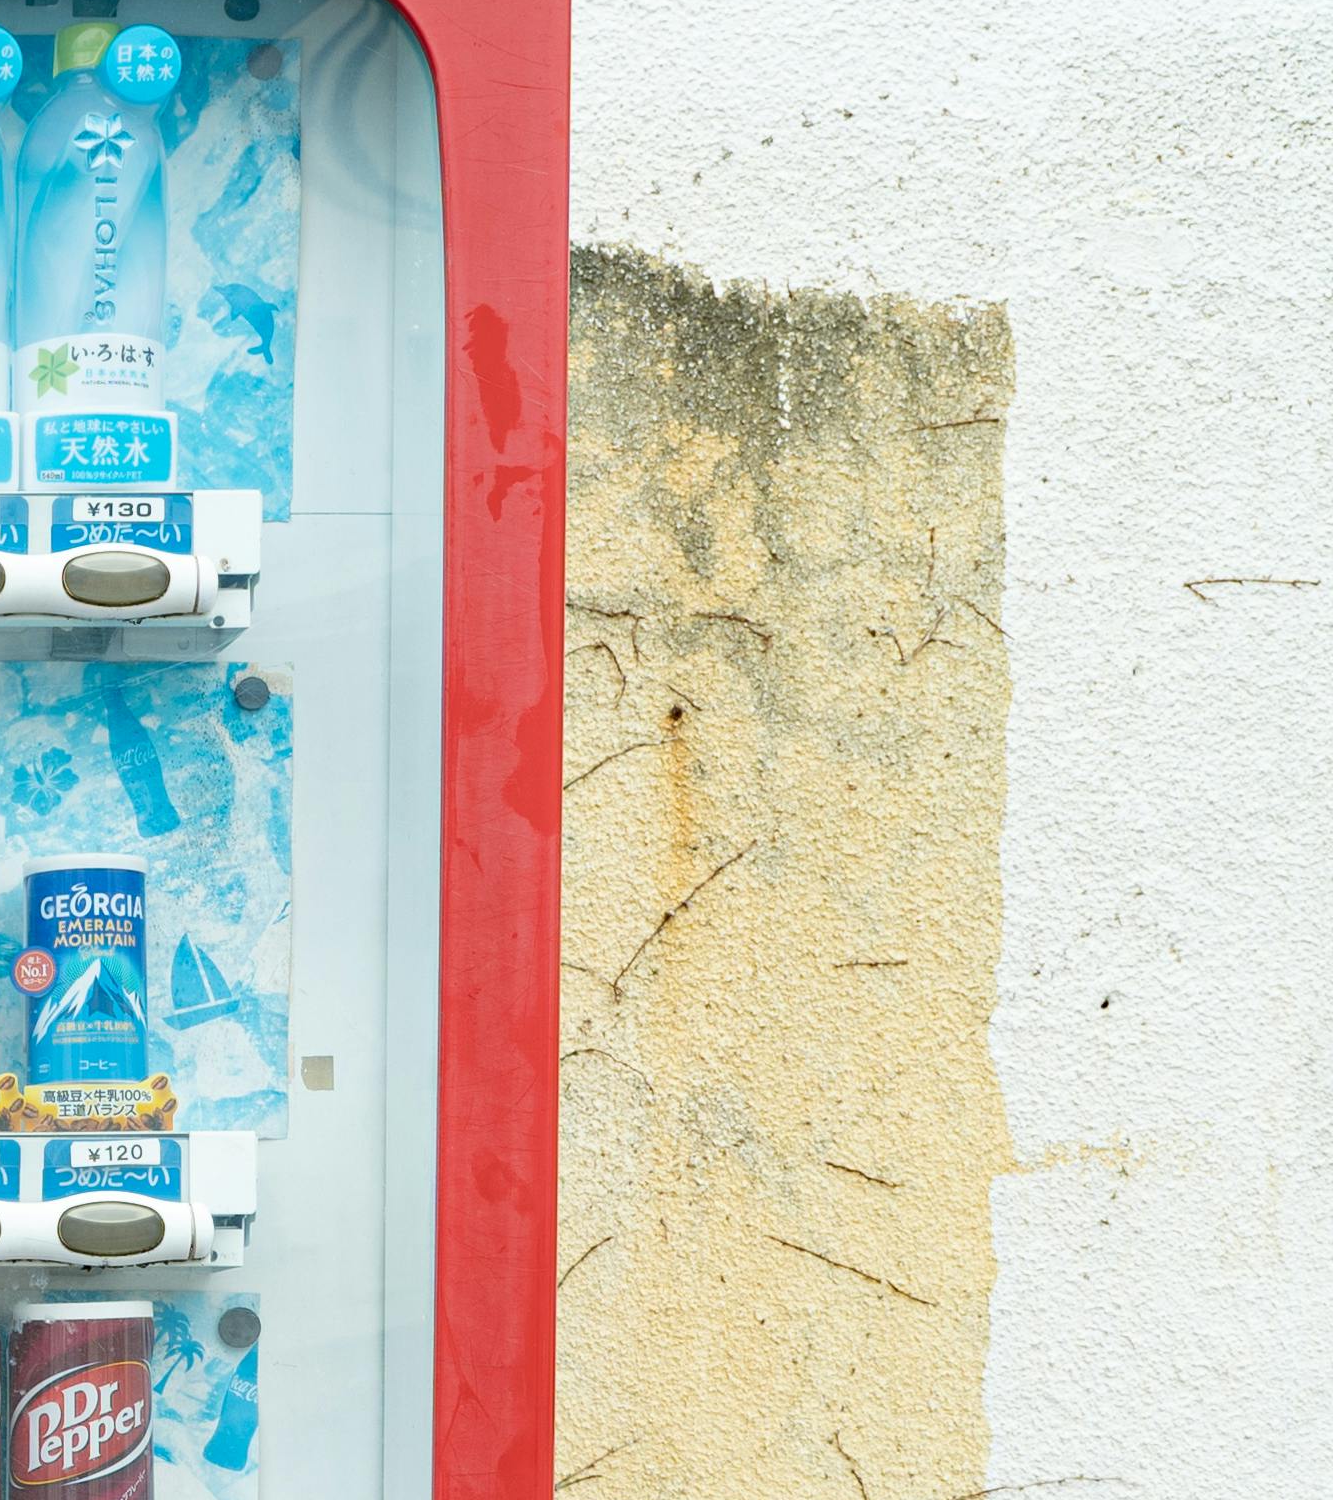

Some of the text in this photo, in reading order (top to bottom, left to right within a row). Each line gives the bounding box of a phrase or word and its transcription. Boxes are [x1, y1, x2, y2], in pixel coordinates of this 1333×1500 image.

[62, 435, 151, 468] 天然水
[88, 502, 152, 517] ¥130
[41, 884, 143, 920] GEORGIA
[88, 1144, 143, 1162] ¥120
[61, 1378, 118, 1426] Dr
[28, 1399, 145, 1471] Pepper
